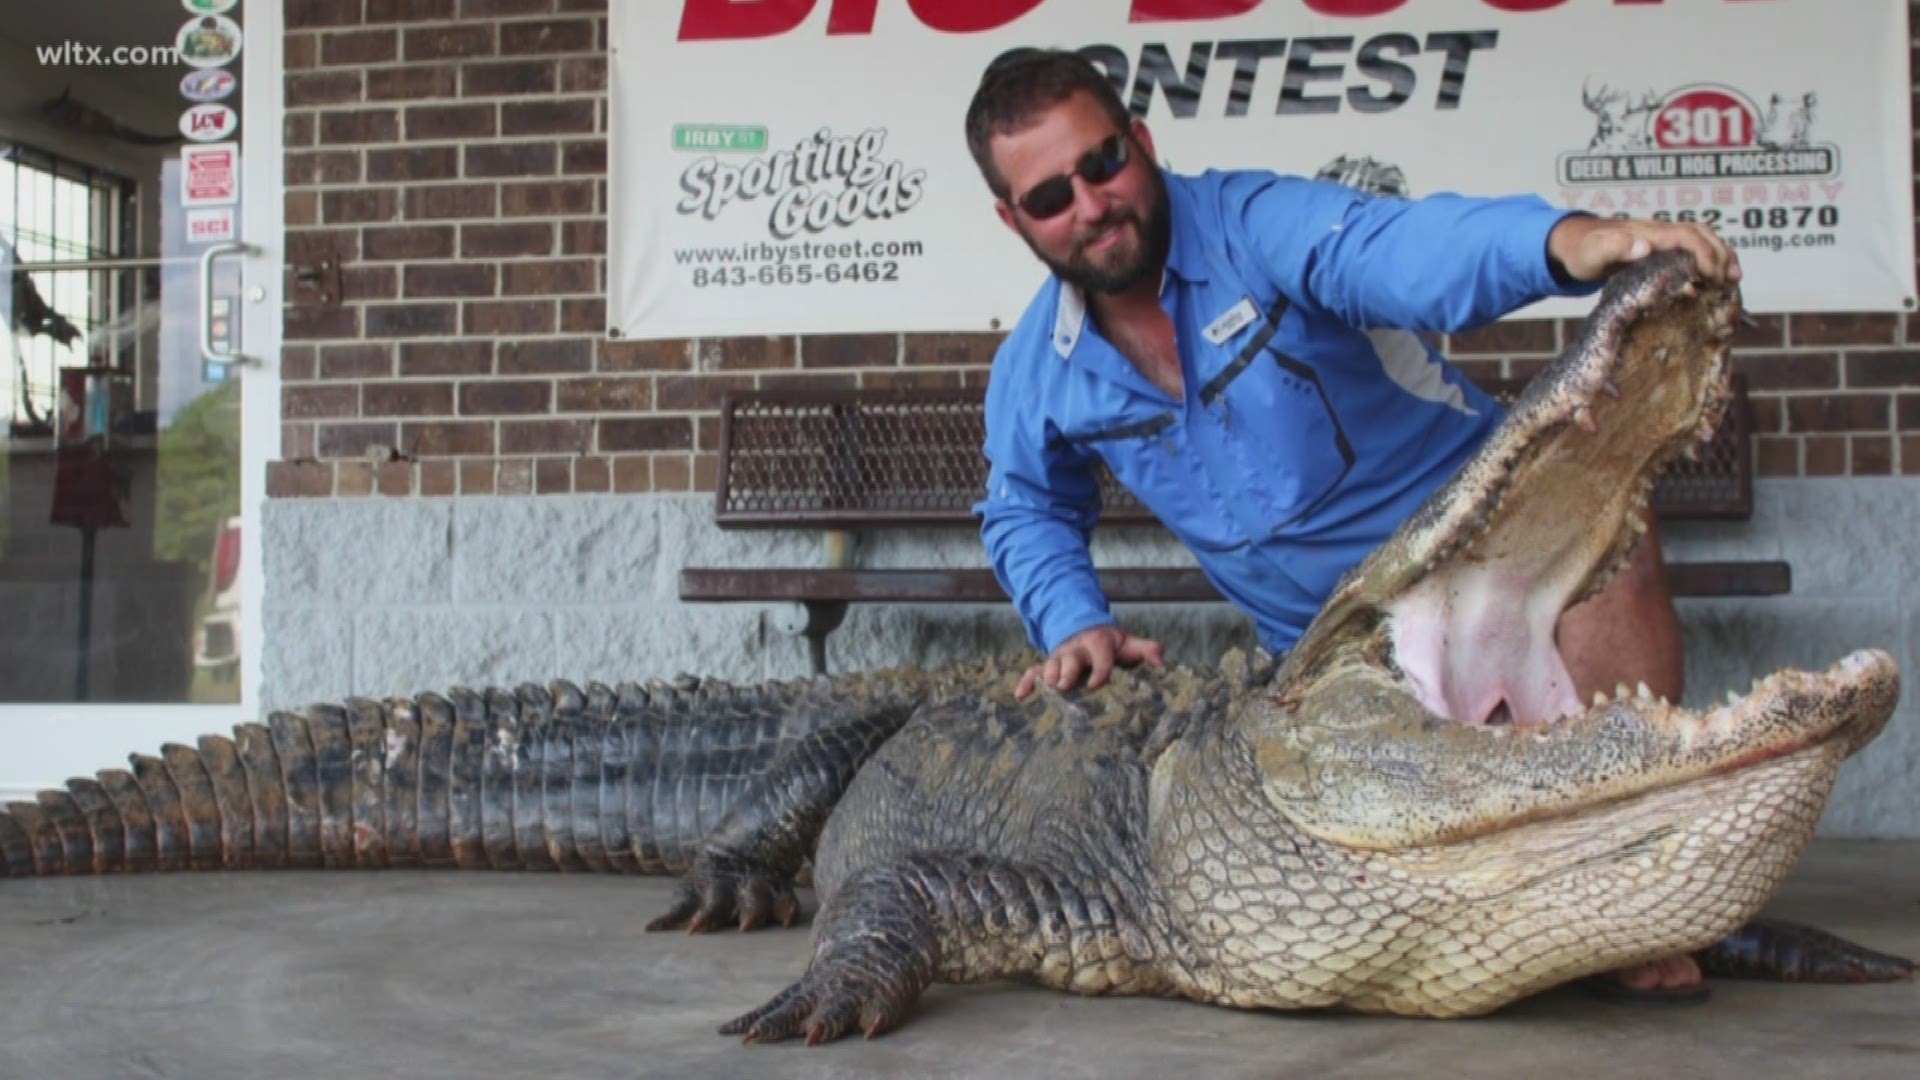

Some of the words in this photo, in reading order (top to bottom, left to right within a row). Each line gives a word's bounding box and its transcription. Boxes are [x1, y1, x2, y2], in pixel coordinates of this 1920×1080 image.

[684, 131, 736, 147] IRBY
[1660, 107, 1745, 144] 301
[676, 127, 888, 221] Sporting
[1569, 156, 1613, 181] DEER
[1617, 156, 1630, 178] &
[1634, 154, 1677, 178] WILD
[1681, 152, 1716, 176] HOG
[1720, 149, 1828, 174] PROCESSING
[768, 161, 927, 240] Goods
[1559, 182, 1844, 210] TAXIDERMY
[674, 239, 923, 266] www.irbystreet.com
[692, 260, 899, 288] 843-665-6462
